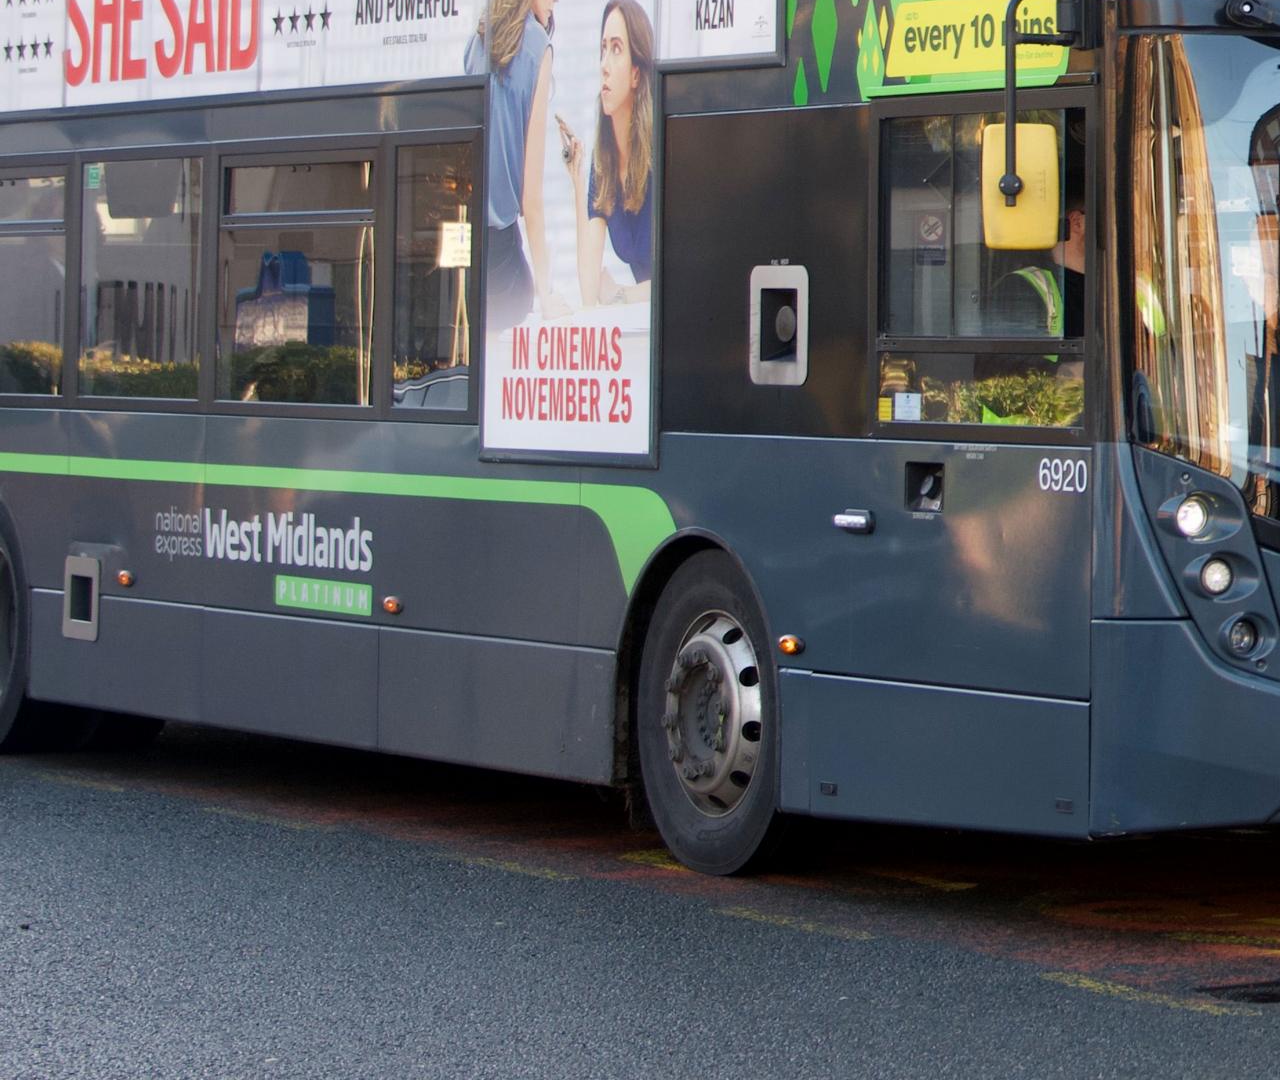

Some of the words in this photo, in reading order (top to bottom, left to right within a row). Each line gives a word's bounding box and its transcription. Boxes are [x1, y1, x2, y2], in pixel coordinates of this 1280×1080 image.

[904, 22, 965, 60] every
[970, 13, 995, 49] 10
[512, 326, 530, 370] IN
[537, 326, 623, 371] CINEMAS
[502, 377, 601, 423] NOVEMBER
[608, 378, 633, 424] 25
[1039, 458, 1088, 493] 6920
[155, 506, 202, 534] national
[204, 507, 262, 563] West
[266, 511, 373, 572] Midlands
[155, 534, 202, 562] express
[278, 579, 369, 610] PLATINUM
